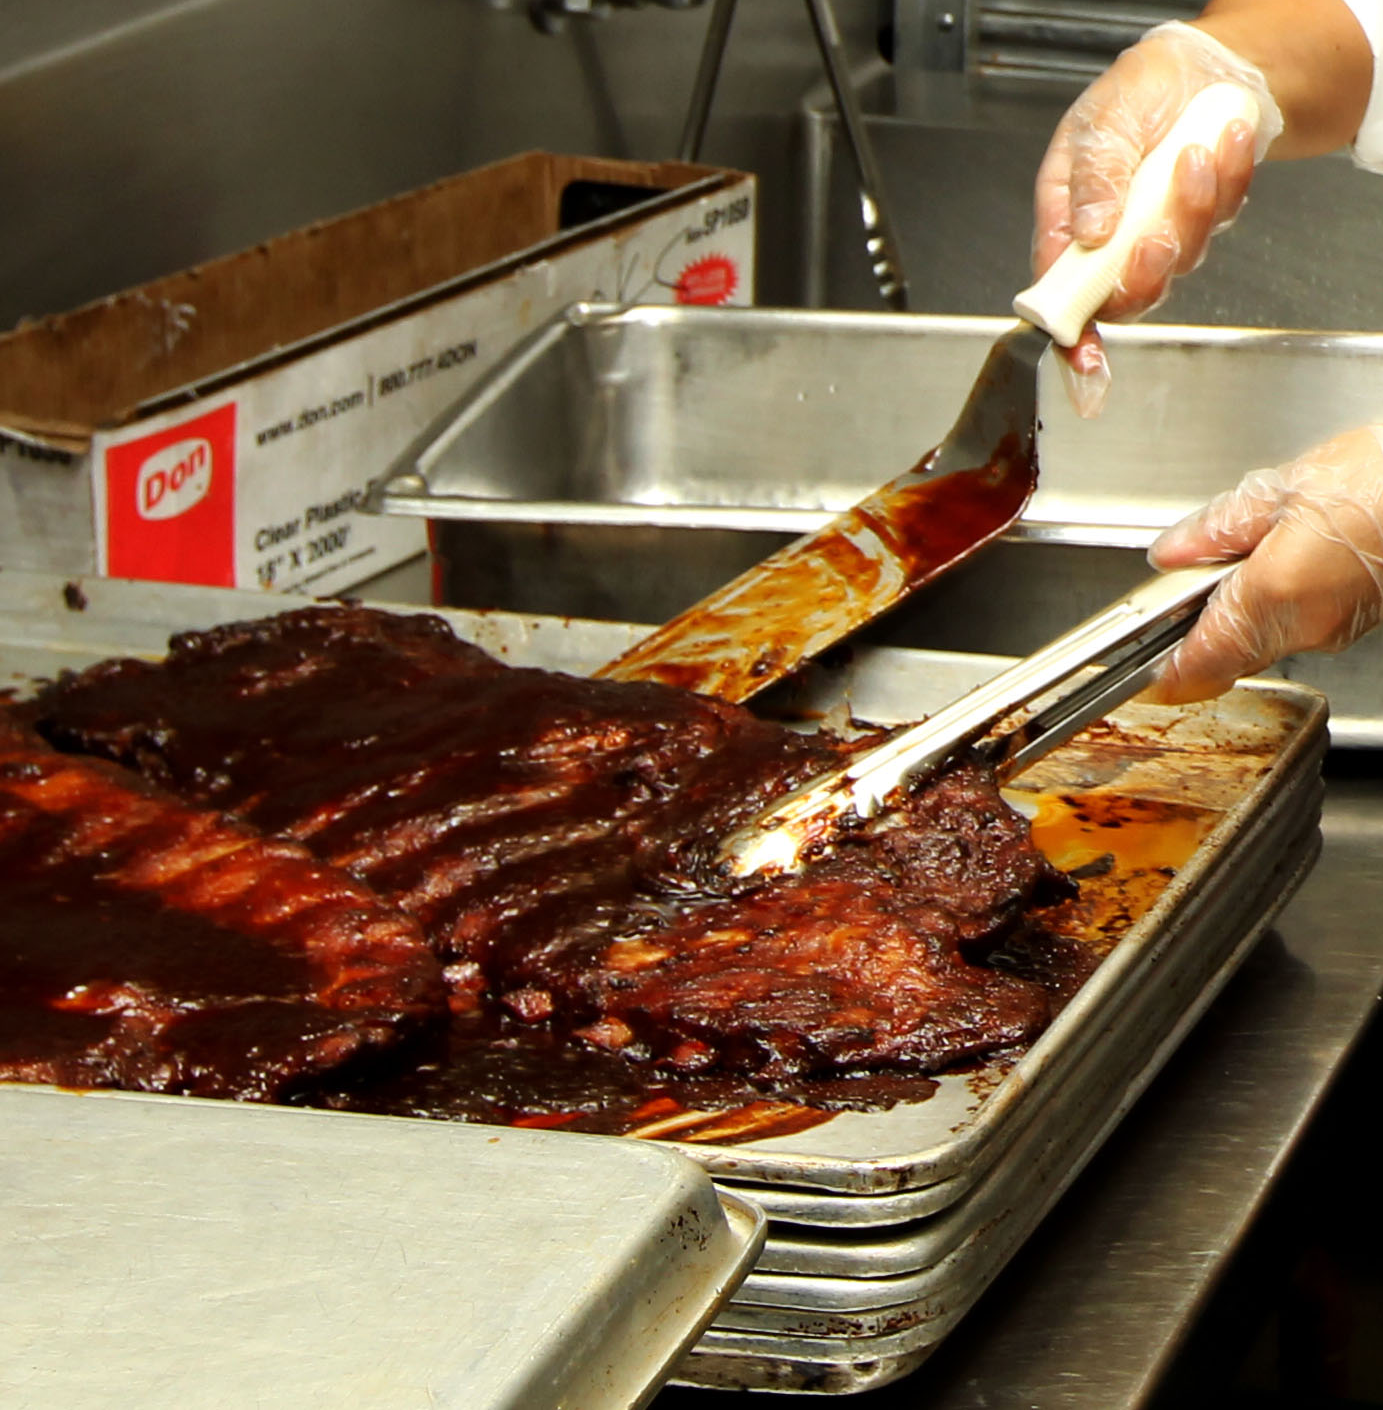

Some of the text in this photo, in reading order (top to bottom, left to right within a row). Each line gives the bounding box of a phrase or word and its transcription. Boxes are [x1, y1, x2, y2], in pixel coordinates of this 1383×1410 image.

[256, 390, 365, 448] www.don.com
[145, 444, 207, 511] Don
[255, 489, 364, 552] Clear Plastic
